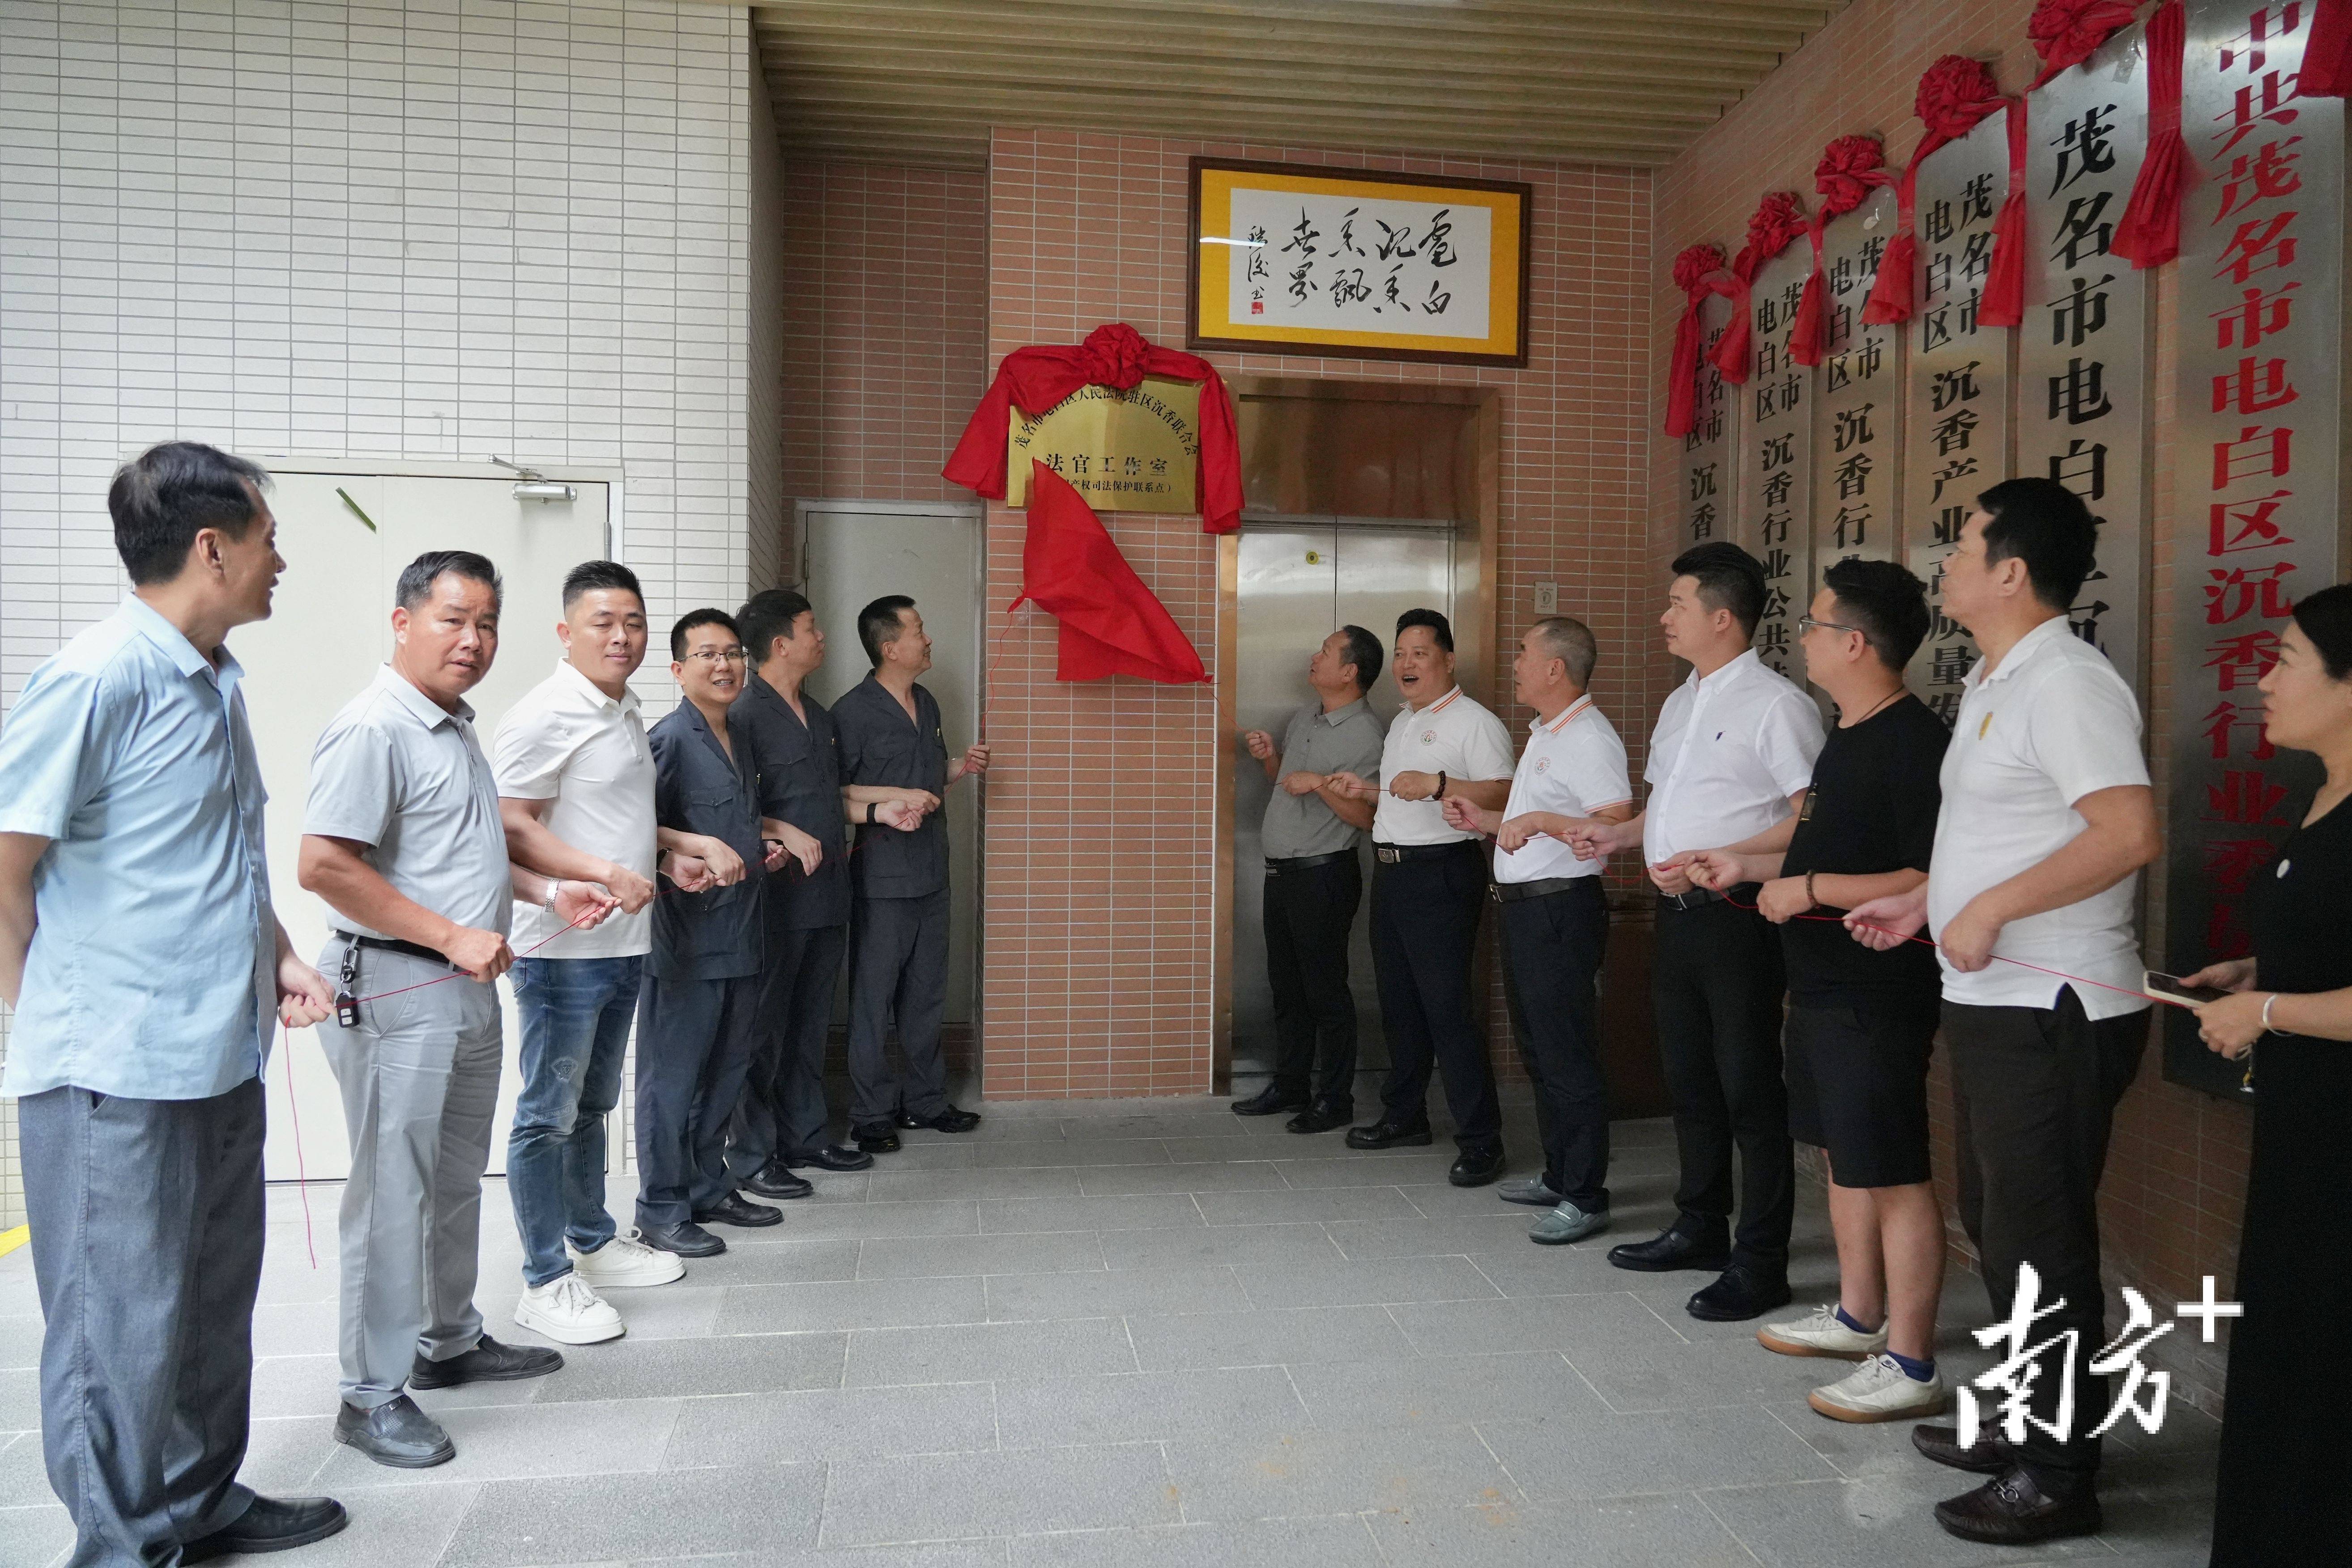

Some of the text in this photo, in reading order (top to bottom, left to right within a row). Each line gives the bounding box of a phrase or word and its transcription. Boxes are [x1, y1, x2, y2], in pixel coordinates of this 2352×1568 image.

[1828, 256, 1853, 393] 电白区
[1923, 200, 1954, 354] 电白区
[1756, 298, 1777, 423] 电白区
[2046, 103, 2117, 659] 茂名市电白
[1046, 453, 1168, 476] 法官工作室
[1690, 462, 1717, 541] 沉香
[1833, 403, 1874, 560] 沉香行
[2200, 2, 2302, 959] 中共茂名市电白区沉香行业委
